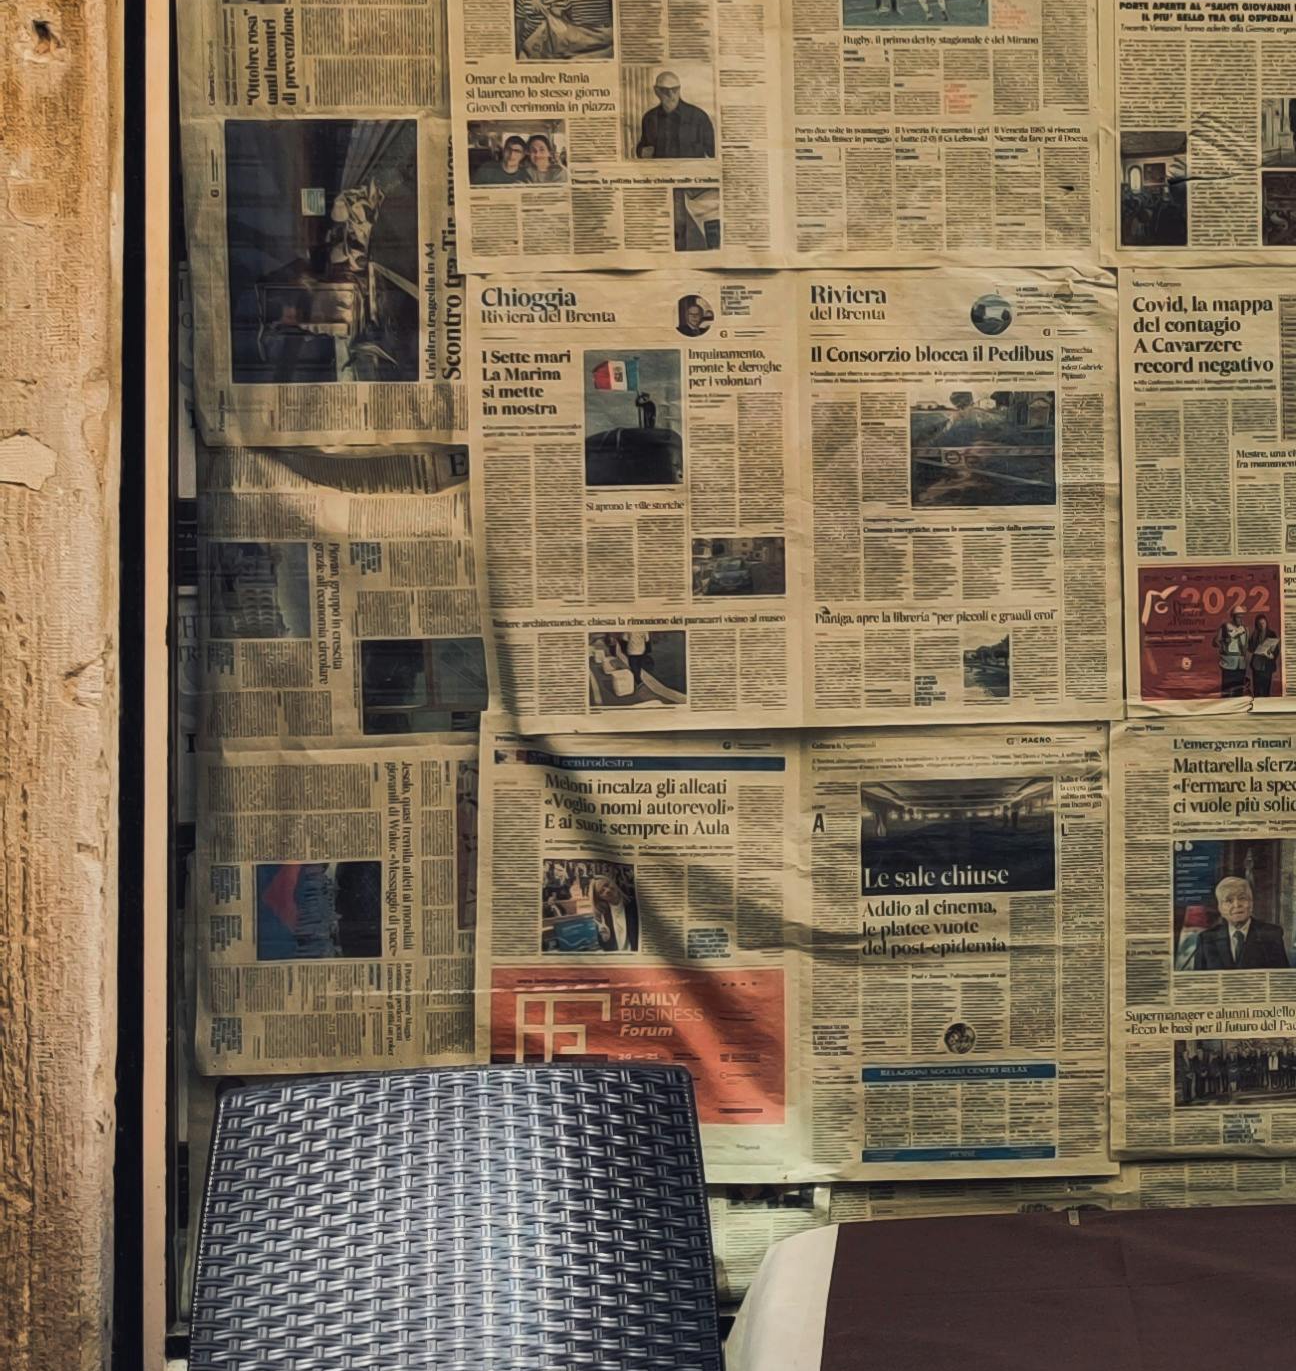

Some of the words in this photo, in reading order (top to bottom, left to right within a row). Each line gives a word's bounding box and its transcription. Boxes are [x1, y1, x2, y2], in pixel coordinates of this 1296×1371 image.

[482, 288, 576, 310] Chioggia
[811, 286, 886, 304] Riviera
[810, 306, 832, 320] del
[837, 308, 885, 320] Brenta
[1133, 296, 1188, 313] Covid,
[1192, 296, 1208, 311] la
[1213, 300, 1273, 315] mappa
[482, 309, 538, 323] Riviera
[538, 309, 561, 322] del
[566, 310, 616, 322] Brenta
[1134, 316, 1160, 332] del
[1164, 317, 1240, 335] contagio
[1134, 338, 1148, 353] A
[1152, 338, 1242, 352] Cavarzere
[482, 351, 487, 363] I
[491, 351, 530, 364] Sette
[534, 350, 570, 363] mari
[812, 346, 822, 362] Il
[826, 347, 911, 362] Consorzio
[916, 346, 968, 362] blocca
[973, 346, 983, 361] il
[988, 346, 1053, 361] Pedibus
[482, 368, 501, 381] La
[504, 368, 561, 380] Marina
[1134, 357, 1194, 373] record
[1198, 357, 1273, 376] negativo
[1174, 757, 1254, 773] Mattarella
[546, 774, 593, 795] Meloni
[598, 778, 652, 794] incalza
[657, 778, 676, 795] gli
[680, 778, 726, 794] alleati
[1173, 778, 1246, 793] «Fermare
[1250, 776, 1263, 792] la
[1173, 798, 1186, 813] ci
[1190, 796, 1232, 812] vuole
[1236, 797, 1260, 814] più
[865, 868, 889, 888] Le
[895, 866, 935, 886] sale
[941, 865, 1008, 885] chiuse
[862, 900, 912, 917] Addio
[915, 899, 929, 915] al
[933, 900, 996, 915] cinema,
[621, 992, 680, 1006] FAMILY
[619, 1007, 703, 1022] BUSINESS
[620, 1022, 674, 1037] Forum
